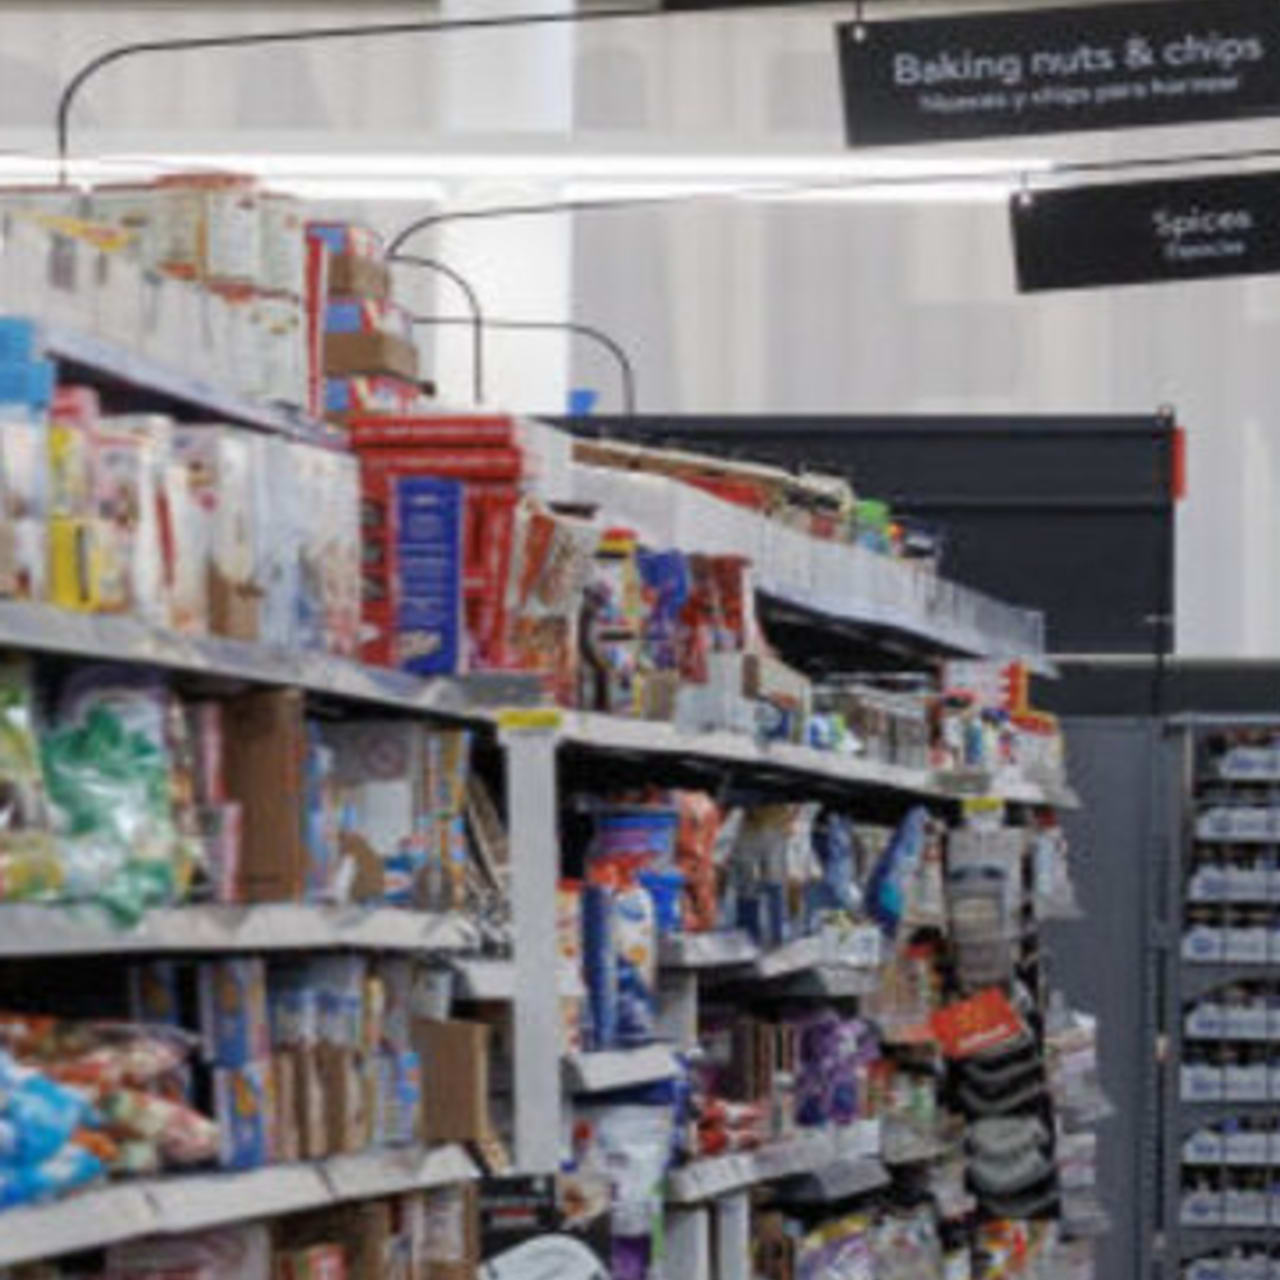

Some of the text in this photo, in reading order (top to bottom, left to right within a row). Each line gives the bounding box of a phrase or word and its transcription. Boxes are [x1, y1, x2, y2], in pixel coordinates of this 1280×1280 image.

[894, 33, 1263, 85] Baking nuts & chips
[1152, 208, 1252, 241] Spices
